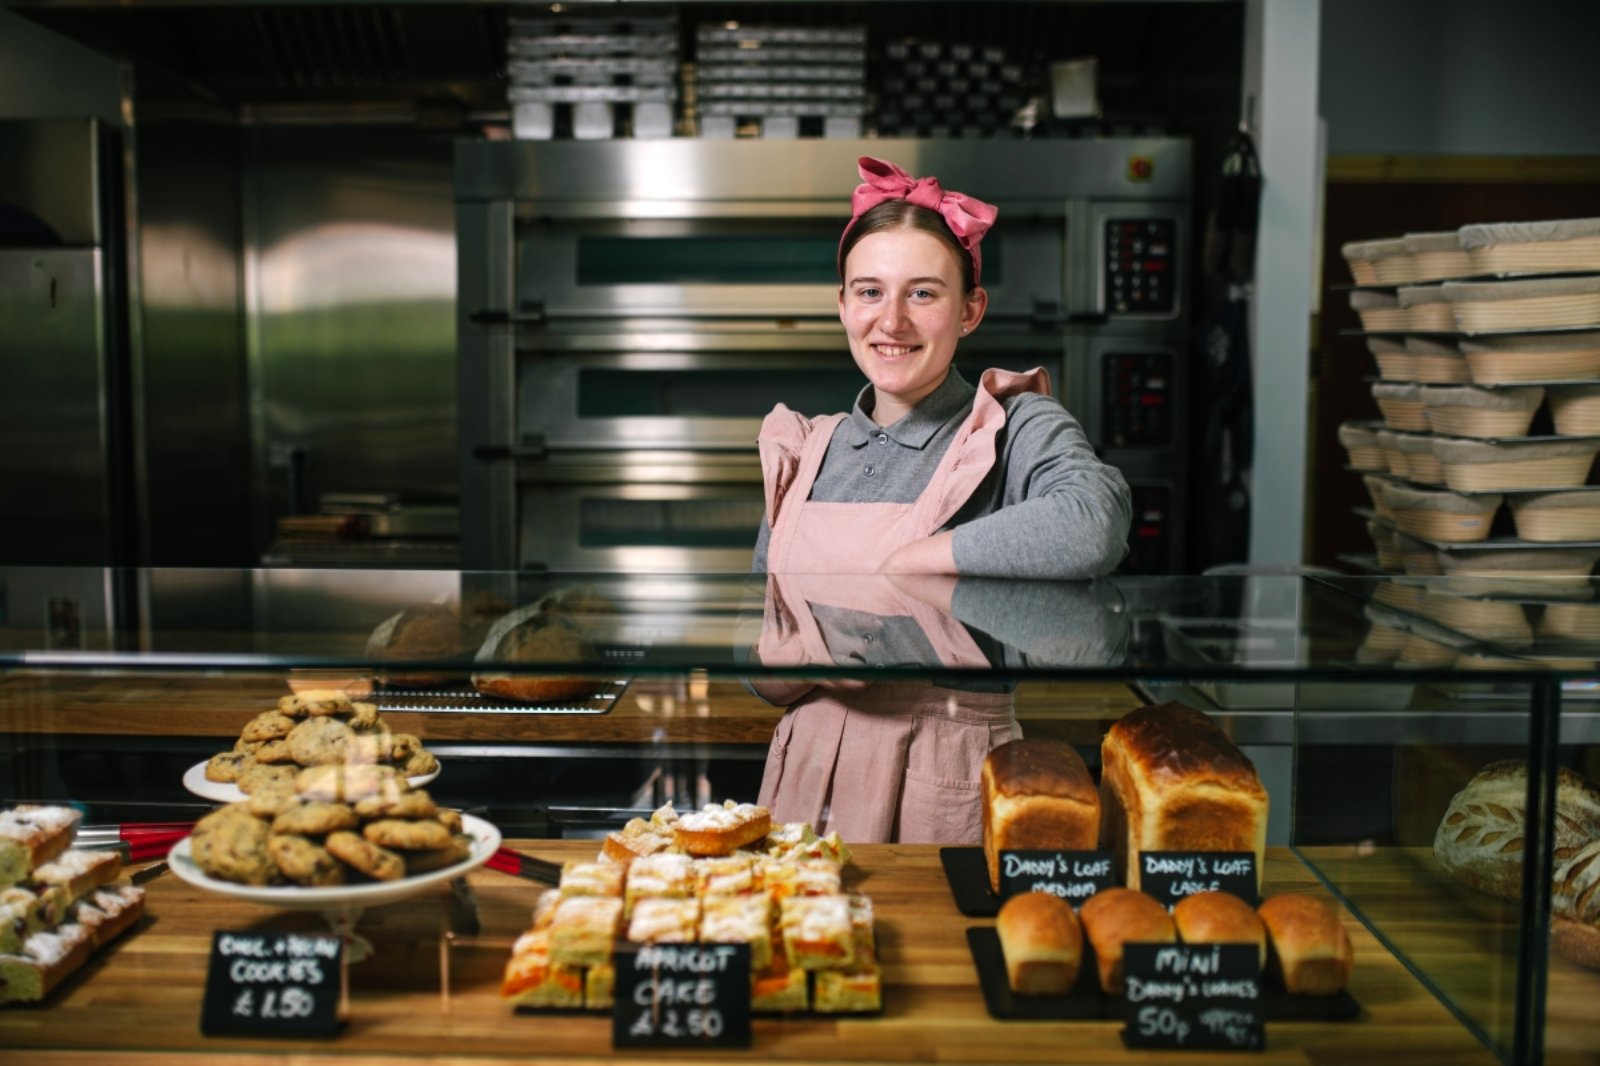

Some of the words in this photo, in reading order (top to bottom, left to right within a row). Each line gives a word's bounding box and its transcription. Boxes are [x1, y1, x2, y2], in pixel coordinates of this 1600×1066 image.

[1073, 860, 1111, 877] LOAF
[1213, 859, 1251, 876] LOAF
[634, 946, 736, 973] APRICOT
[633, 978, 717, 1006] CAKE
